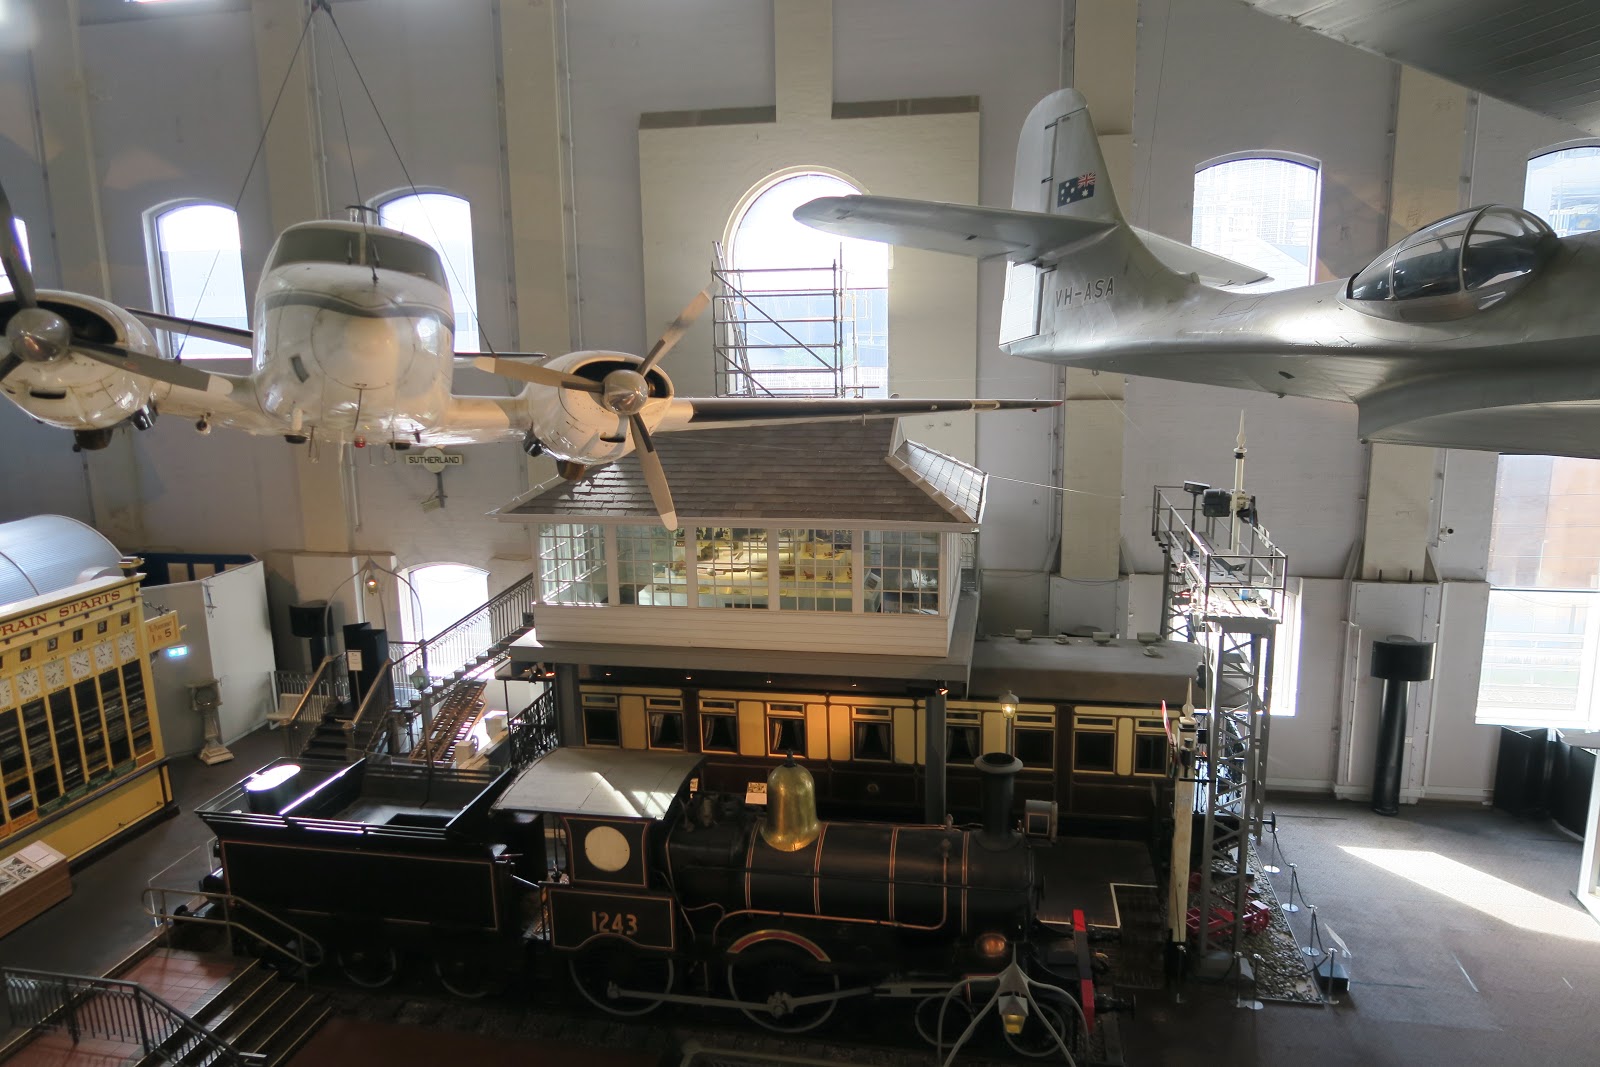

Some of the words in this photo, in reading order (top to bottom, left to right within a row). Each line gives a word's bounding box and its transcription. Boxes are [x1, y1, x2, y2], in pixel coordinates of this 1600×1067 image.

[1055, 278, 1114, 308] VH-ASA
[408, 456, 460, 464] SUTHERLAND
[0, 613, 48, 636] RAIN
[58, 590, 121, 618] STARTS
[164, 628, 172, 638] 5
[591, 910, 638, 936] 1243
